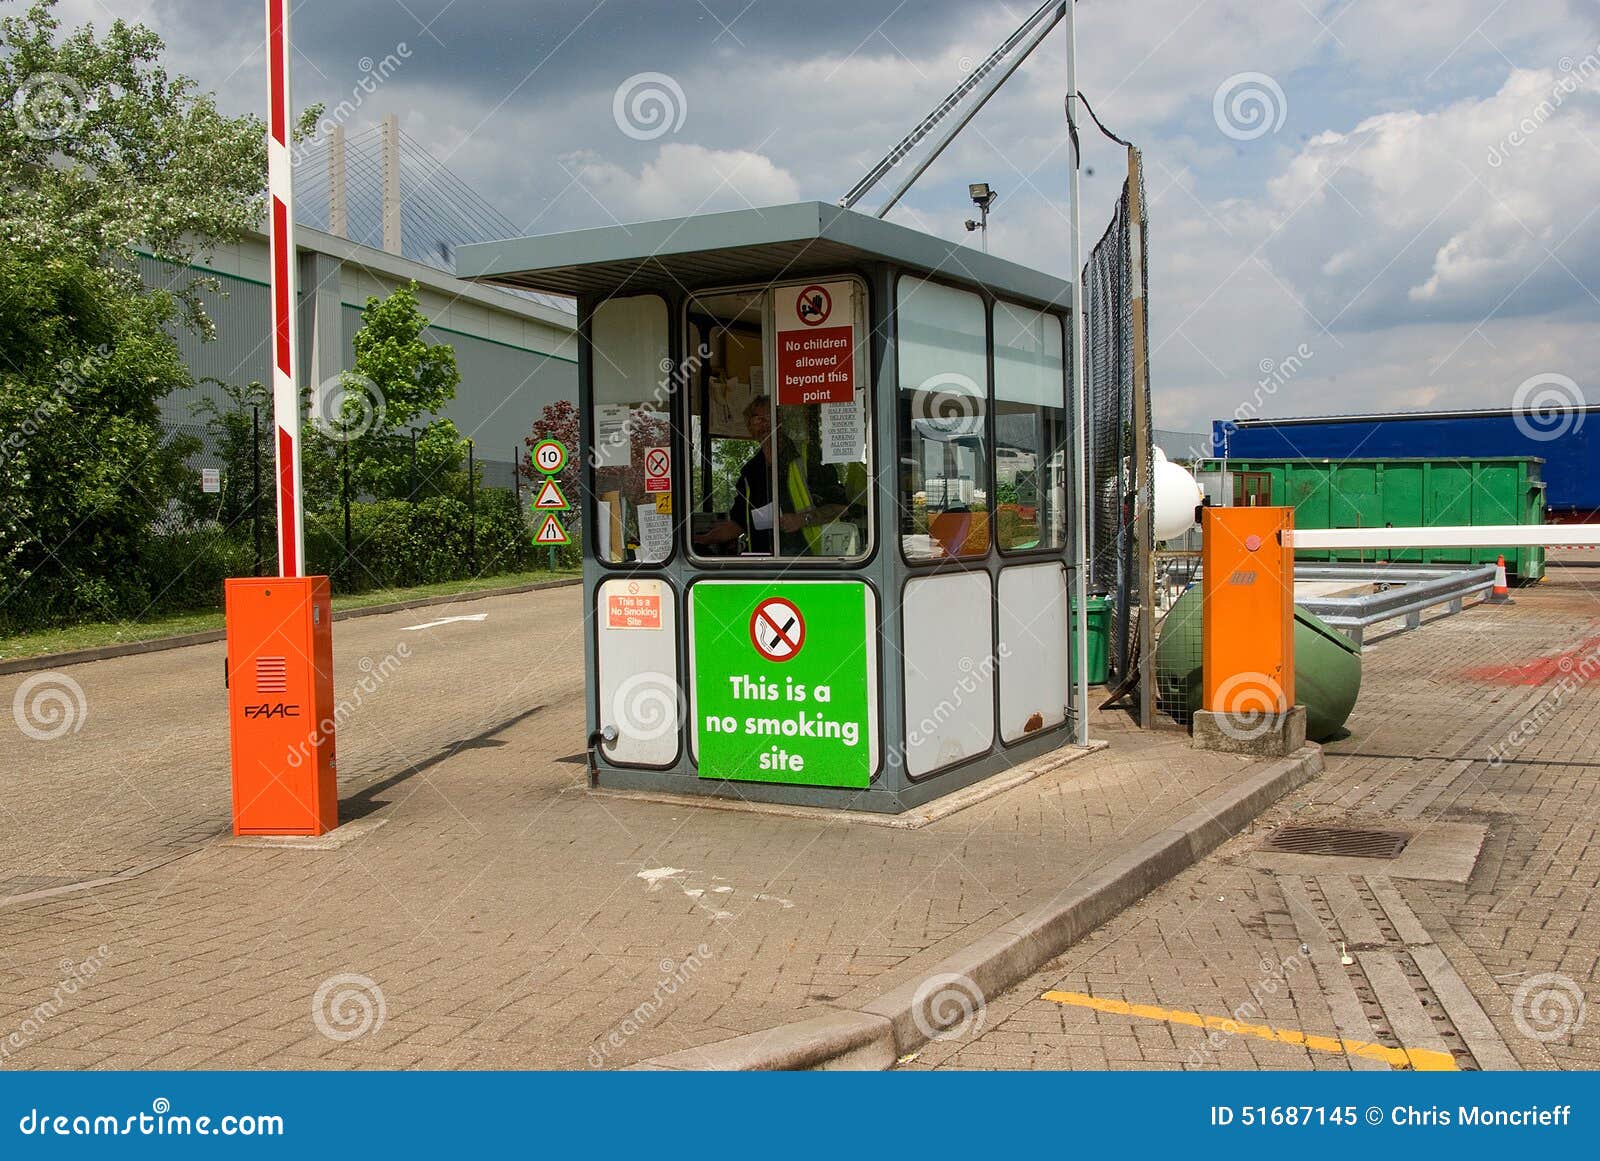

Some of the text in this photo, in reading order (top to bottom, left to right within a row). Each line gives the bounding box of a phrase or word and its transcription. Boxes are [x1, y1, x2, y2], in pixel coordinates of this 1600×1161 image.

[785, 338, 847, 351] No children
[795, 354, 837, 368] allowed
[785, 371, 849, 387] beyond this
[803, 389, 831, 403] point
[541, 451, 558, 463] 10
[618, 597, 635, 607] This
[645, 599, 650, 607] a
[611, 607, 658, 618] No Smoking
[729, 674, 831, 703] This is a
[244, 703, 300, 719] FAAC
[706, 711, 859, 746] no smoking
[759, 745, 804, 772] site
